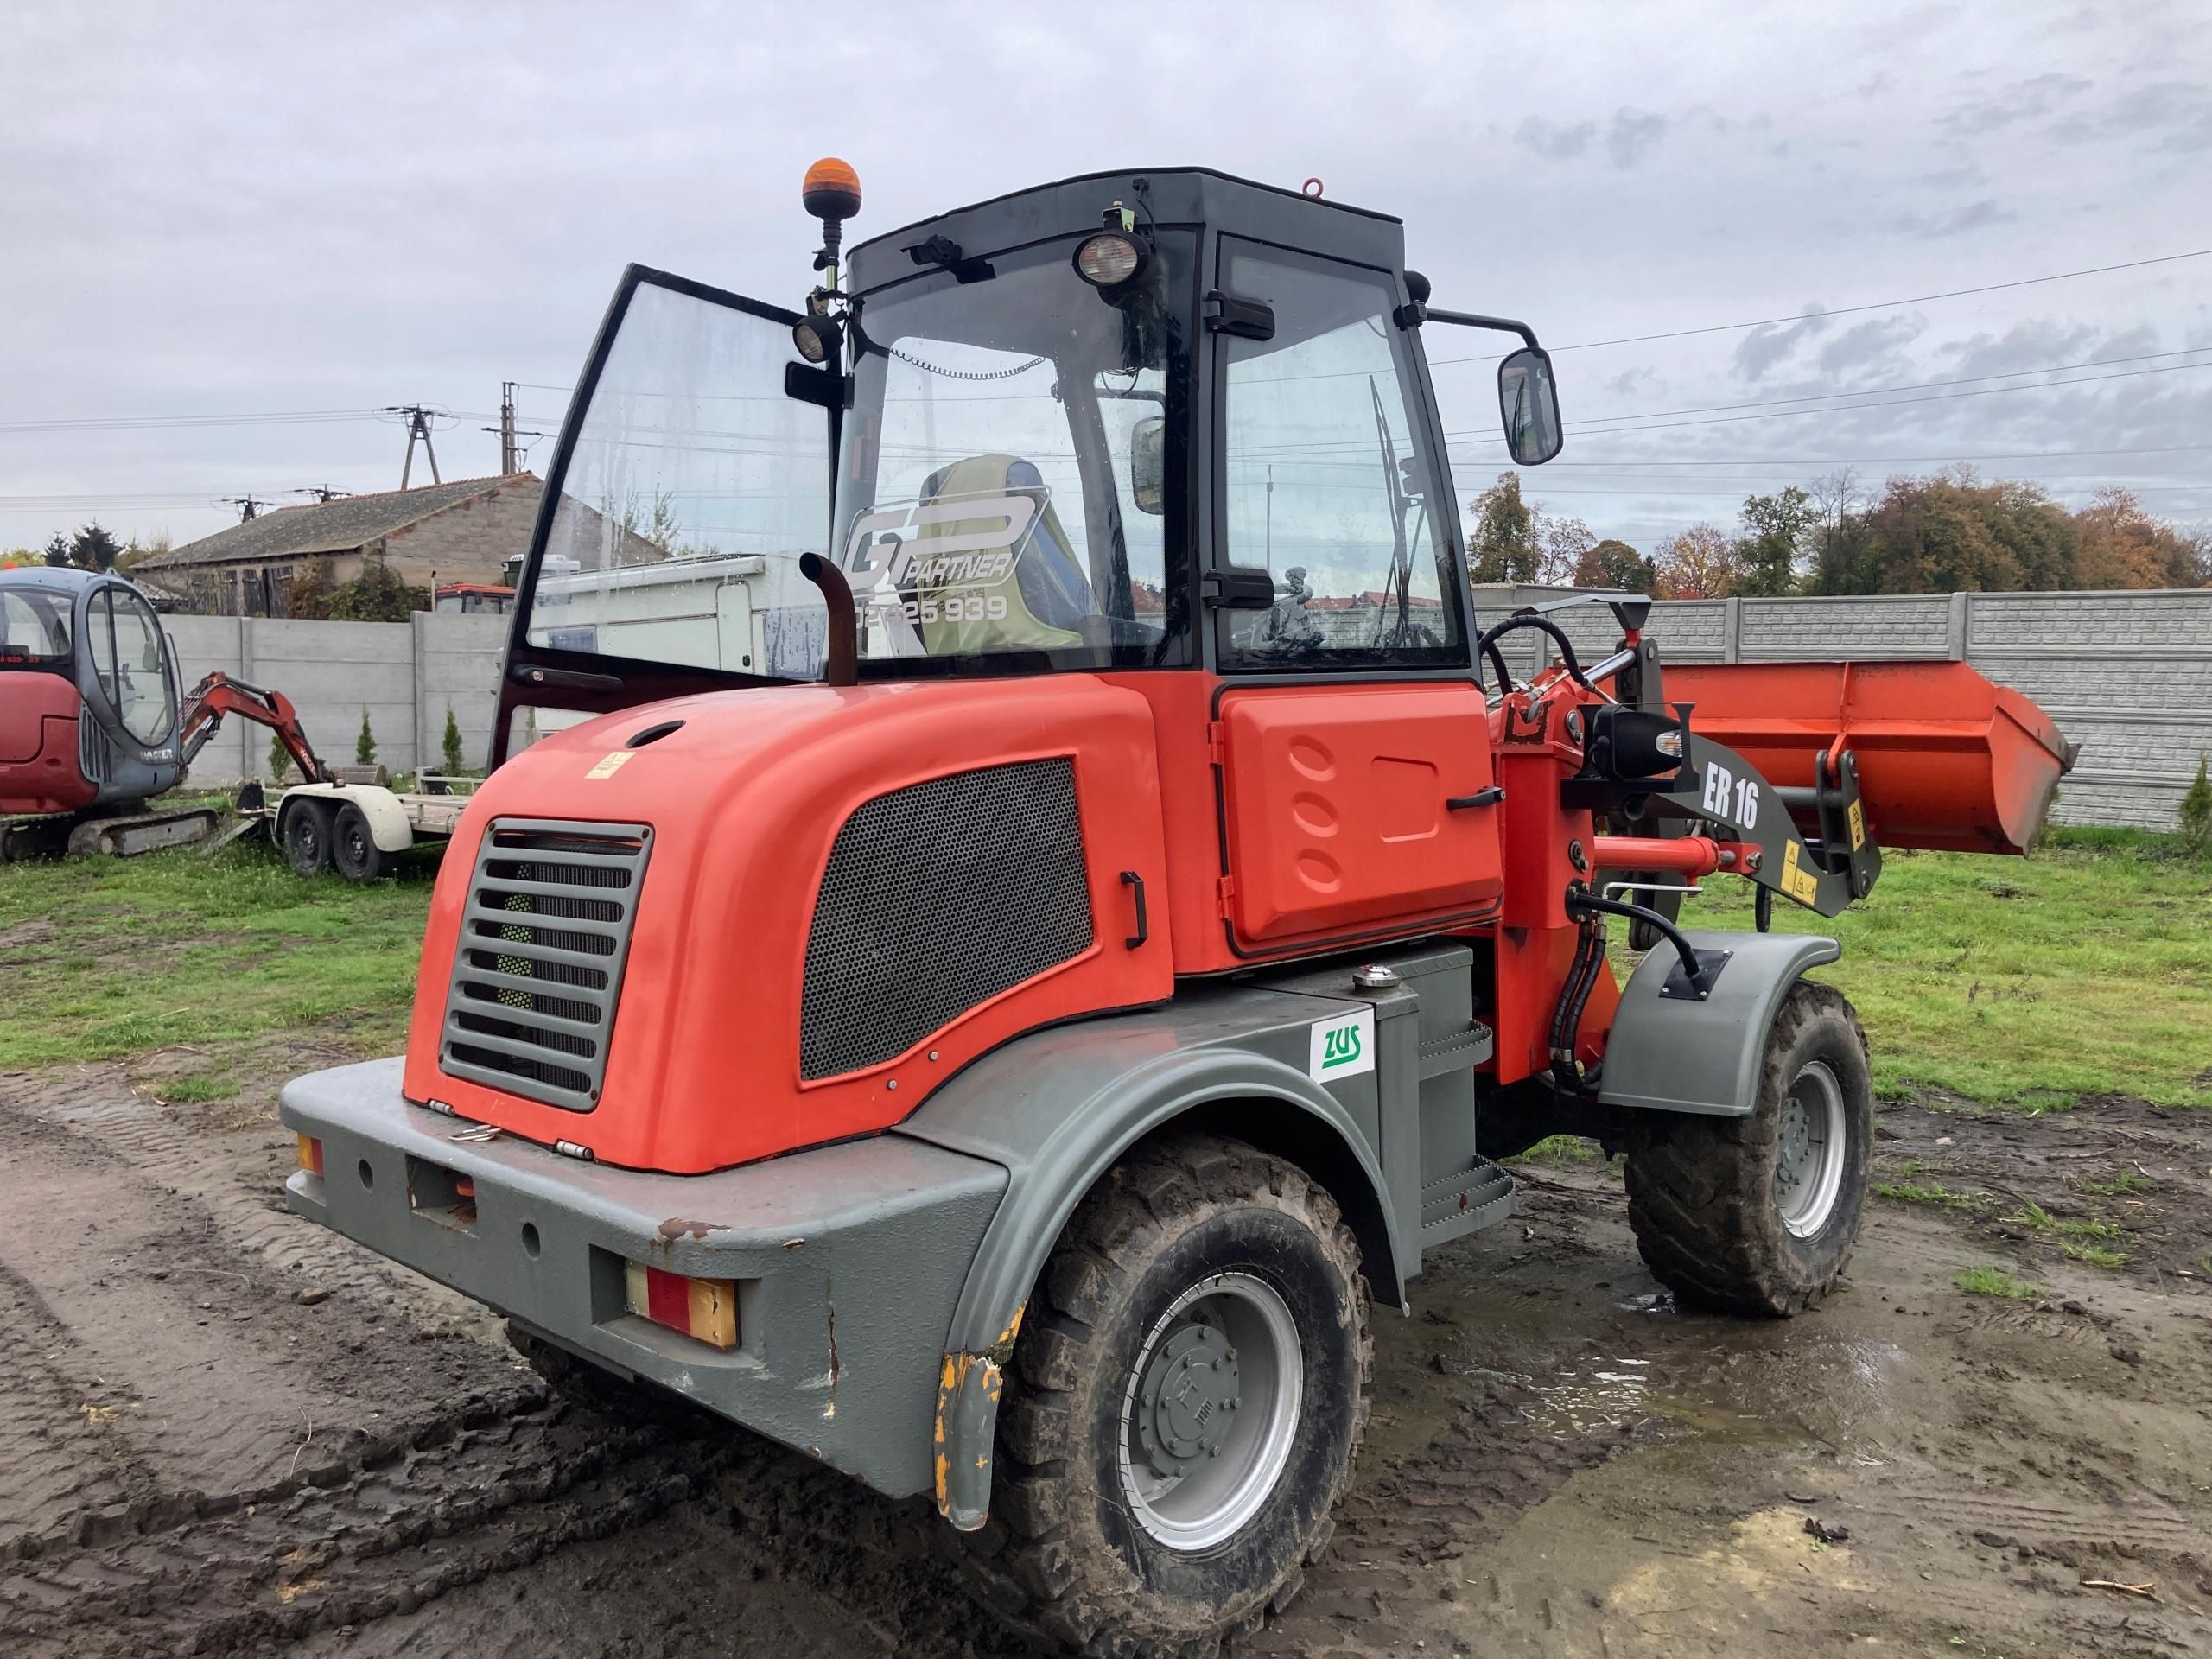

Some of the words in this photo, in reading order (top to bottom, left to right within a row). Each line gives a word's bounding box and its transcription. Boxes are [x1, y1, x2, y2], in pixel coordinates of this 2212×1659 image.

[903, 553, 1012, 583] PARTNER
[945, 596, 1007, 622] 939
[1703, 761, 1731, 818] ER
[1735, 778, 1759, 830] 16
[1321, 1024, 1361, 1069] ZUS
